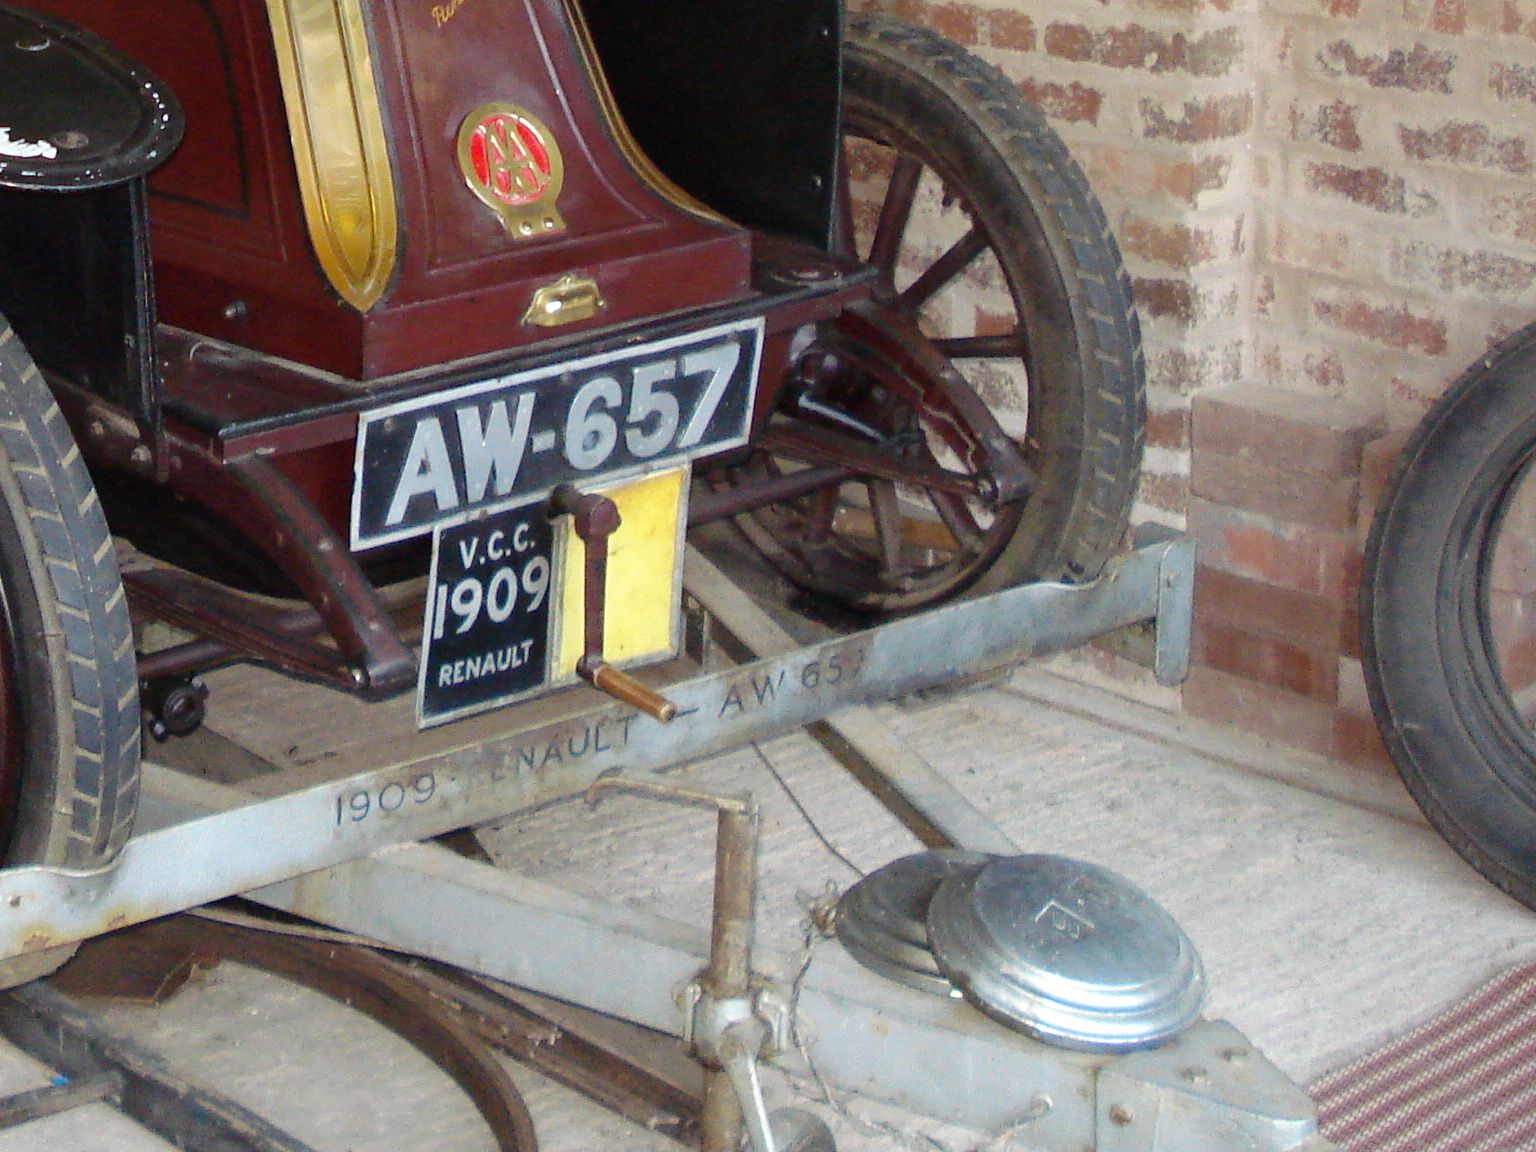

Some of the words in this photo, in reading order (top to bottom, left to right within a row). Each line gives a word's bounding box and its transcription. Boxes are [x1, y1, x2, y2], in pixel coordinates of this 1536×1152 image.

[384, 341, 741, 527] AW-657
[459, 521, 536, 570] V.C.C.
[432, 555, 551, 641] 1909
[438, 639, 534, 688] RENAULT
[336, 773, 437, 826] 1909
[474, 712, 639, 785] ENAULT
[719, 669, 785, 718] AW
